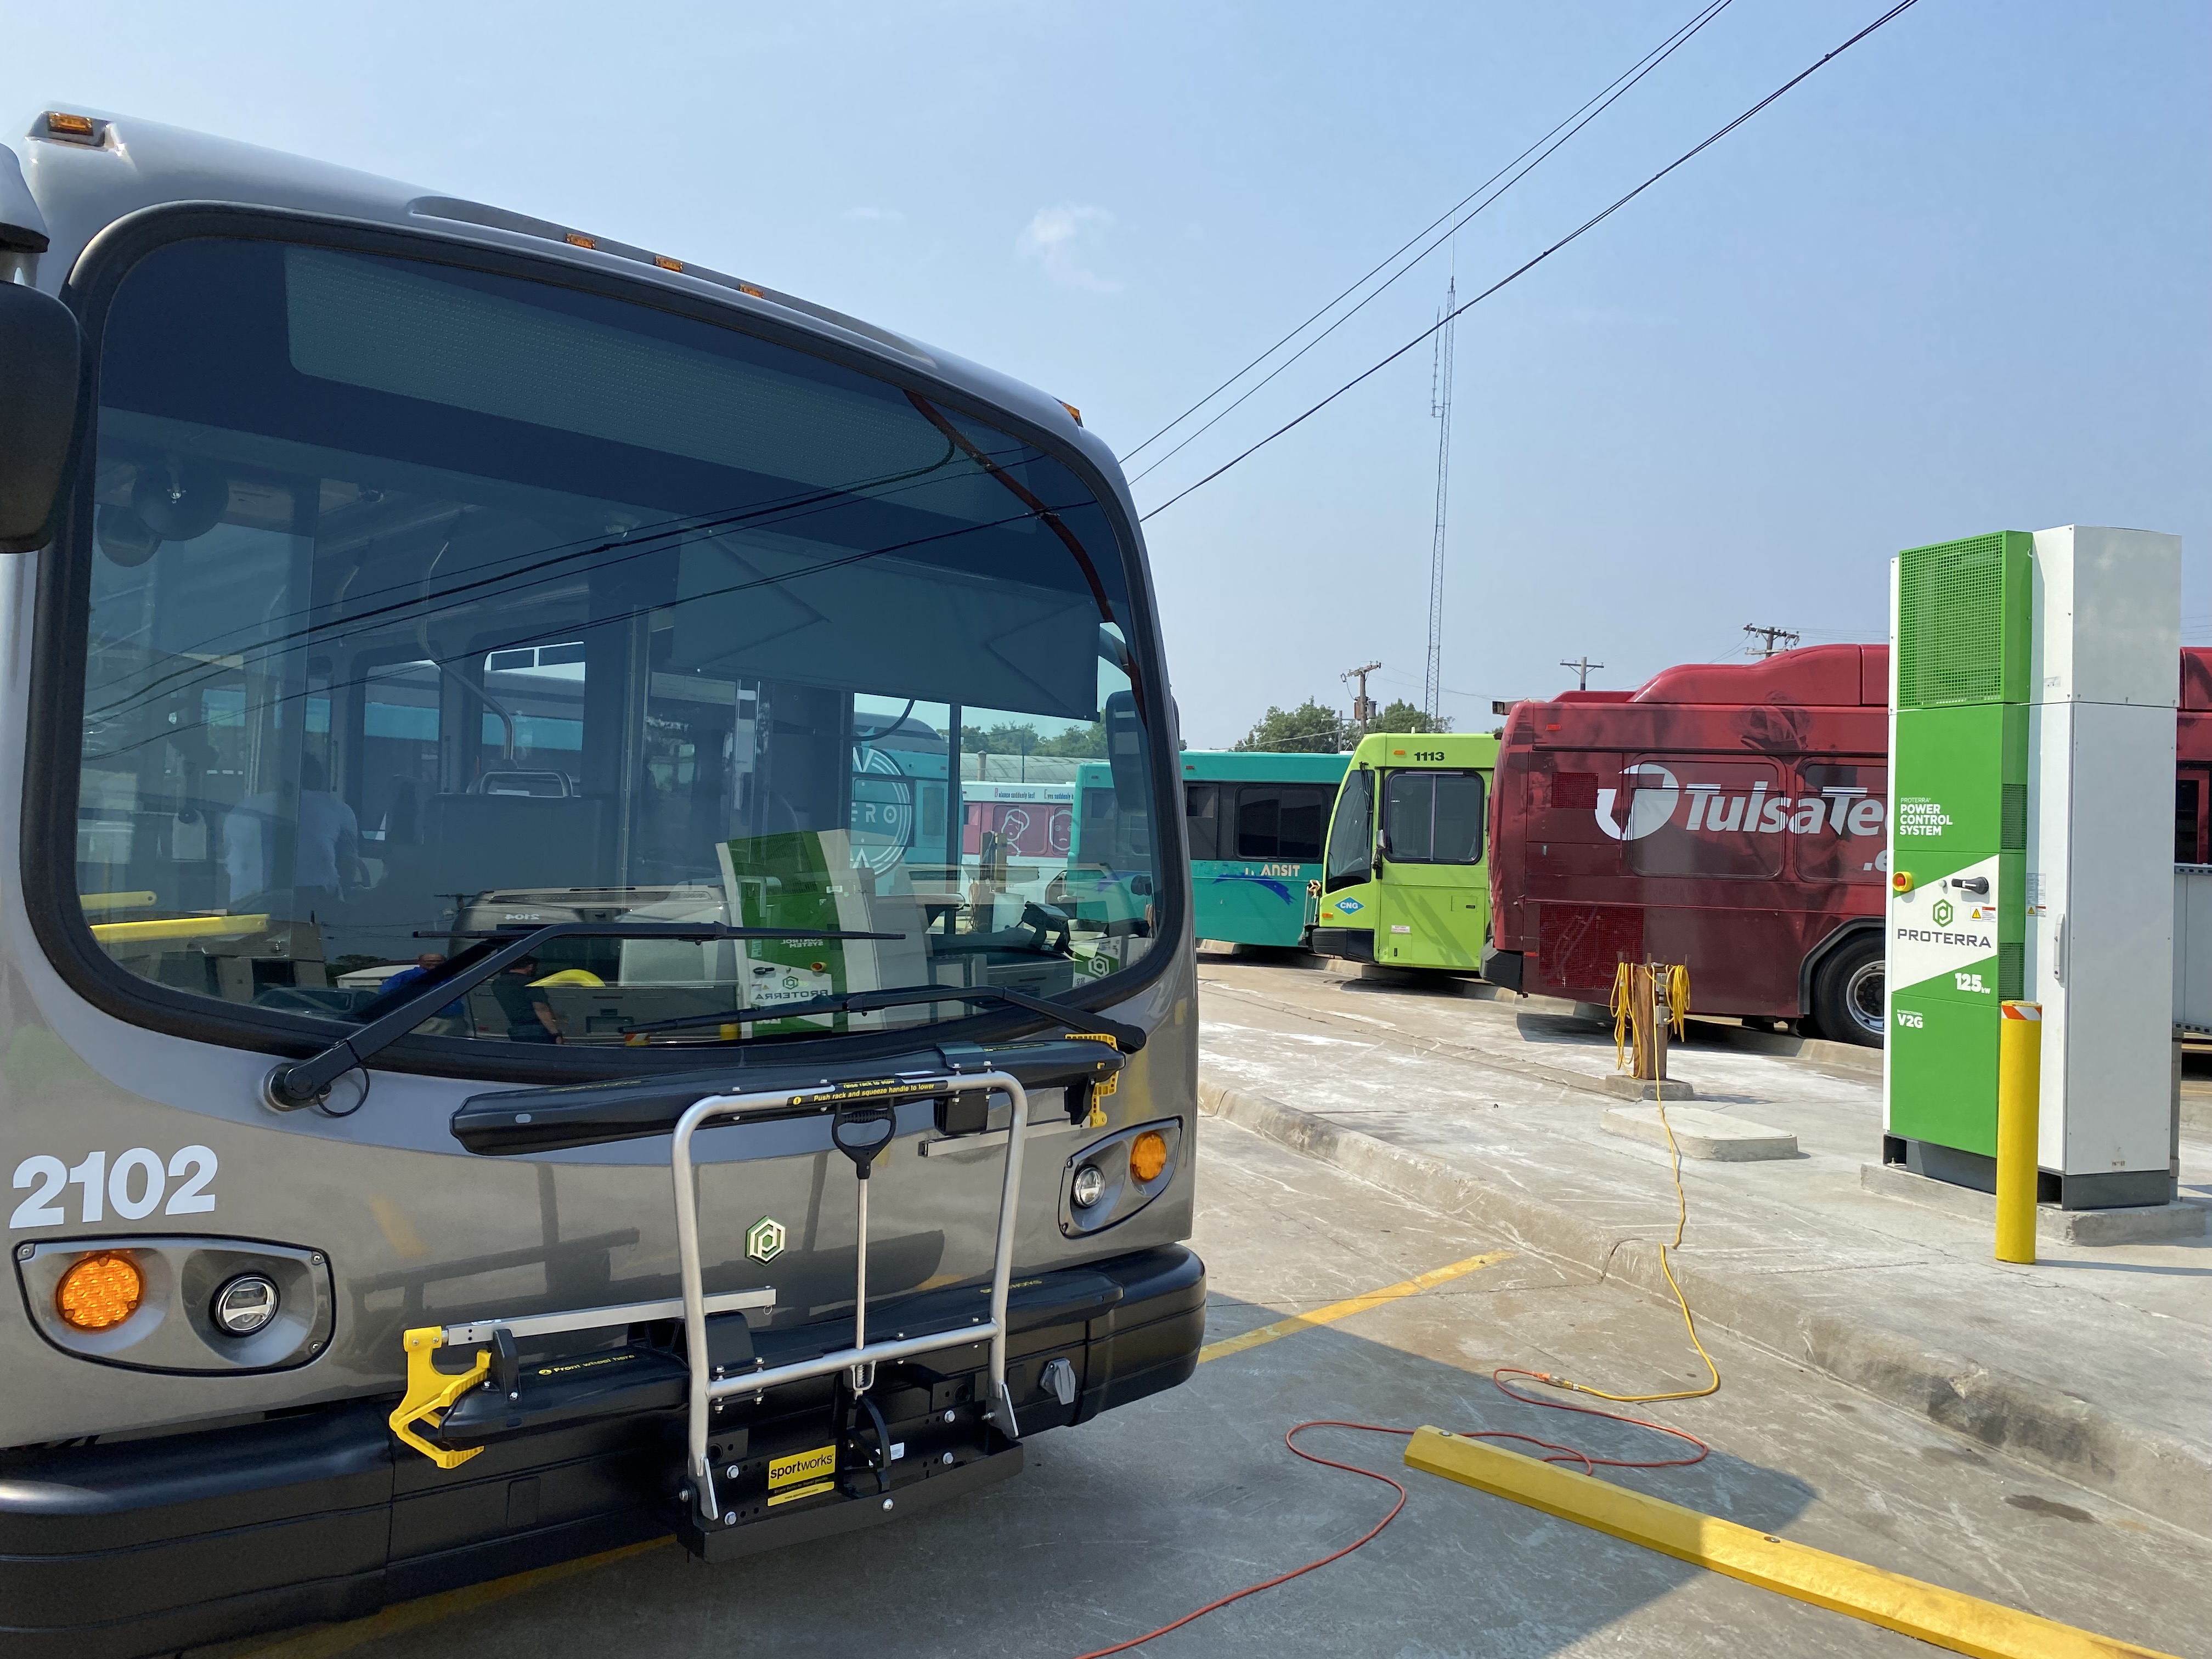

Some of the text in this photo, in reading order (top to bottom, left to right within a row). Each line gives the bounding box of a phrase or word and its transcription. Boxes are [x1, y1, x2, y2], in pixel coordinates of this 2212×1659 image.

[1414, 752, 1444, 761] 1113
[1684, 781, 1887, 836] TulsaTe
[1900, 804, 1941, 814] POWER
[1900, 815, 1953, 825] CONTROL
[1899, 825, 1942, 836] SYSTEM
[1340, 901, 1359, 910] CNG
[1897, 928, 1991, 948] PROTERRA
[1897, 1013, 1923, 1029] V2G
[861, 1088, 887, 1097] squeeze
[9, 1145, 218, 1229] 2102
[582, 1358, 612, 1367] wheel
[770, 1454, 833, 1480] sportworks
